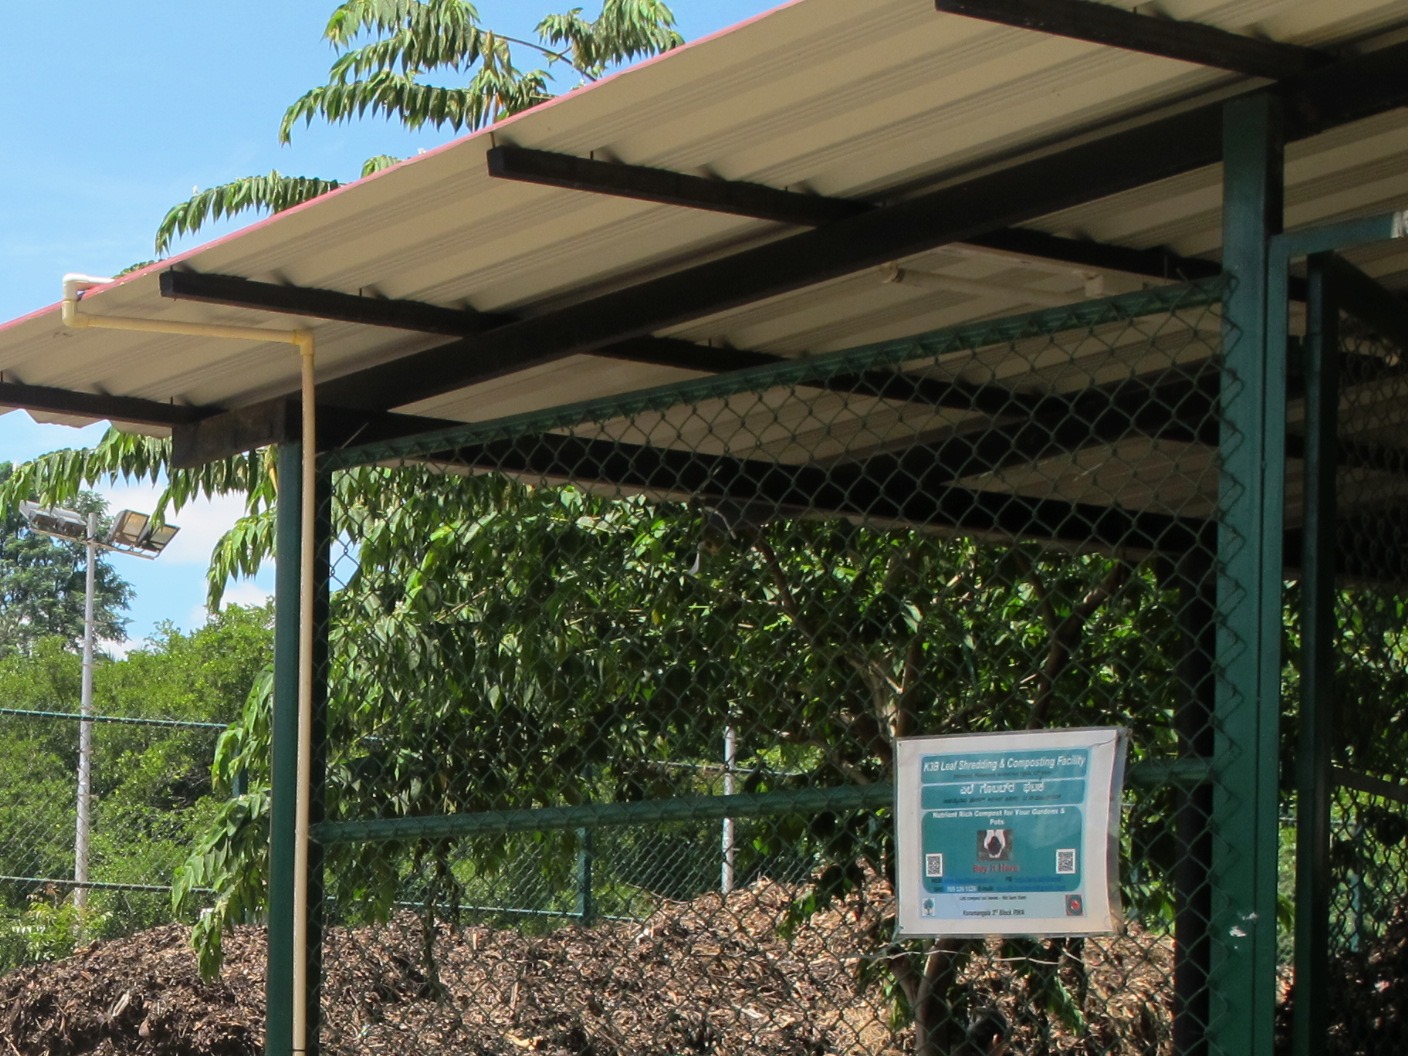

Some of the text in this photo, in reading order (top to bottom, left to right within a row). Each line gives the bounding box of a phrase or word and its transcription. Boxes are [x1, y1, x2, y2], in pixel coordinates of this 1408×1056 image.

[924, 755, 1086, 772] K3B Leaf Shredding & Composting Facility
